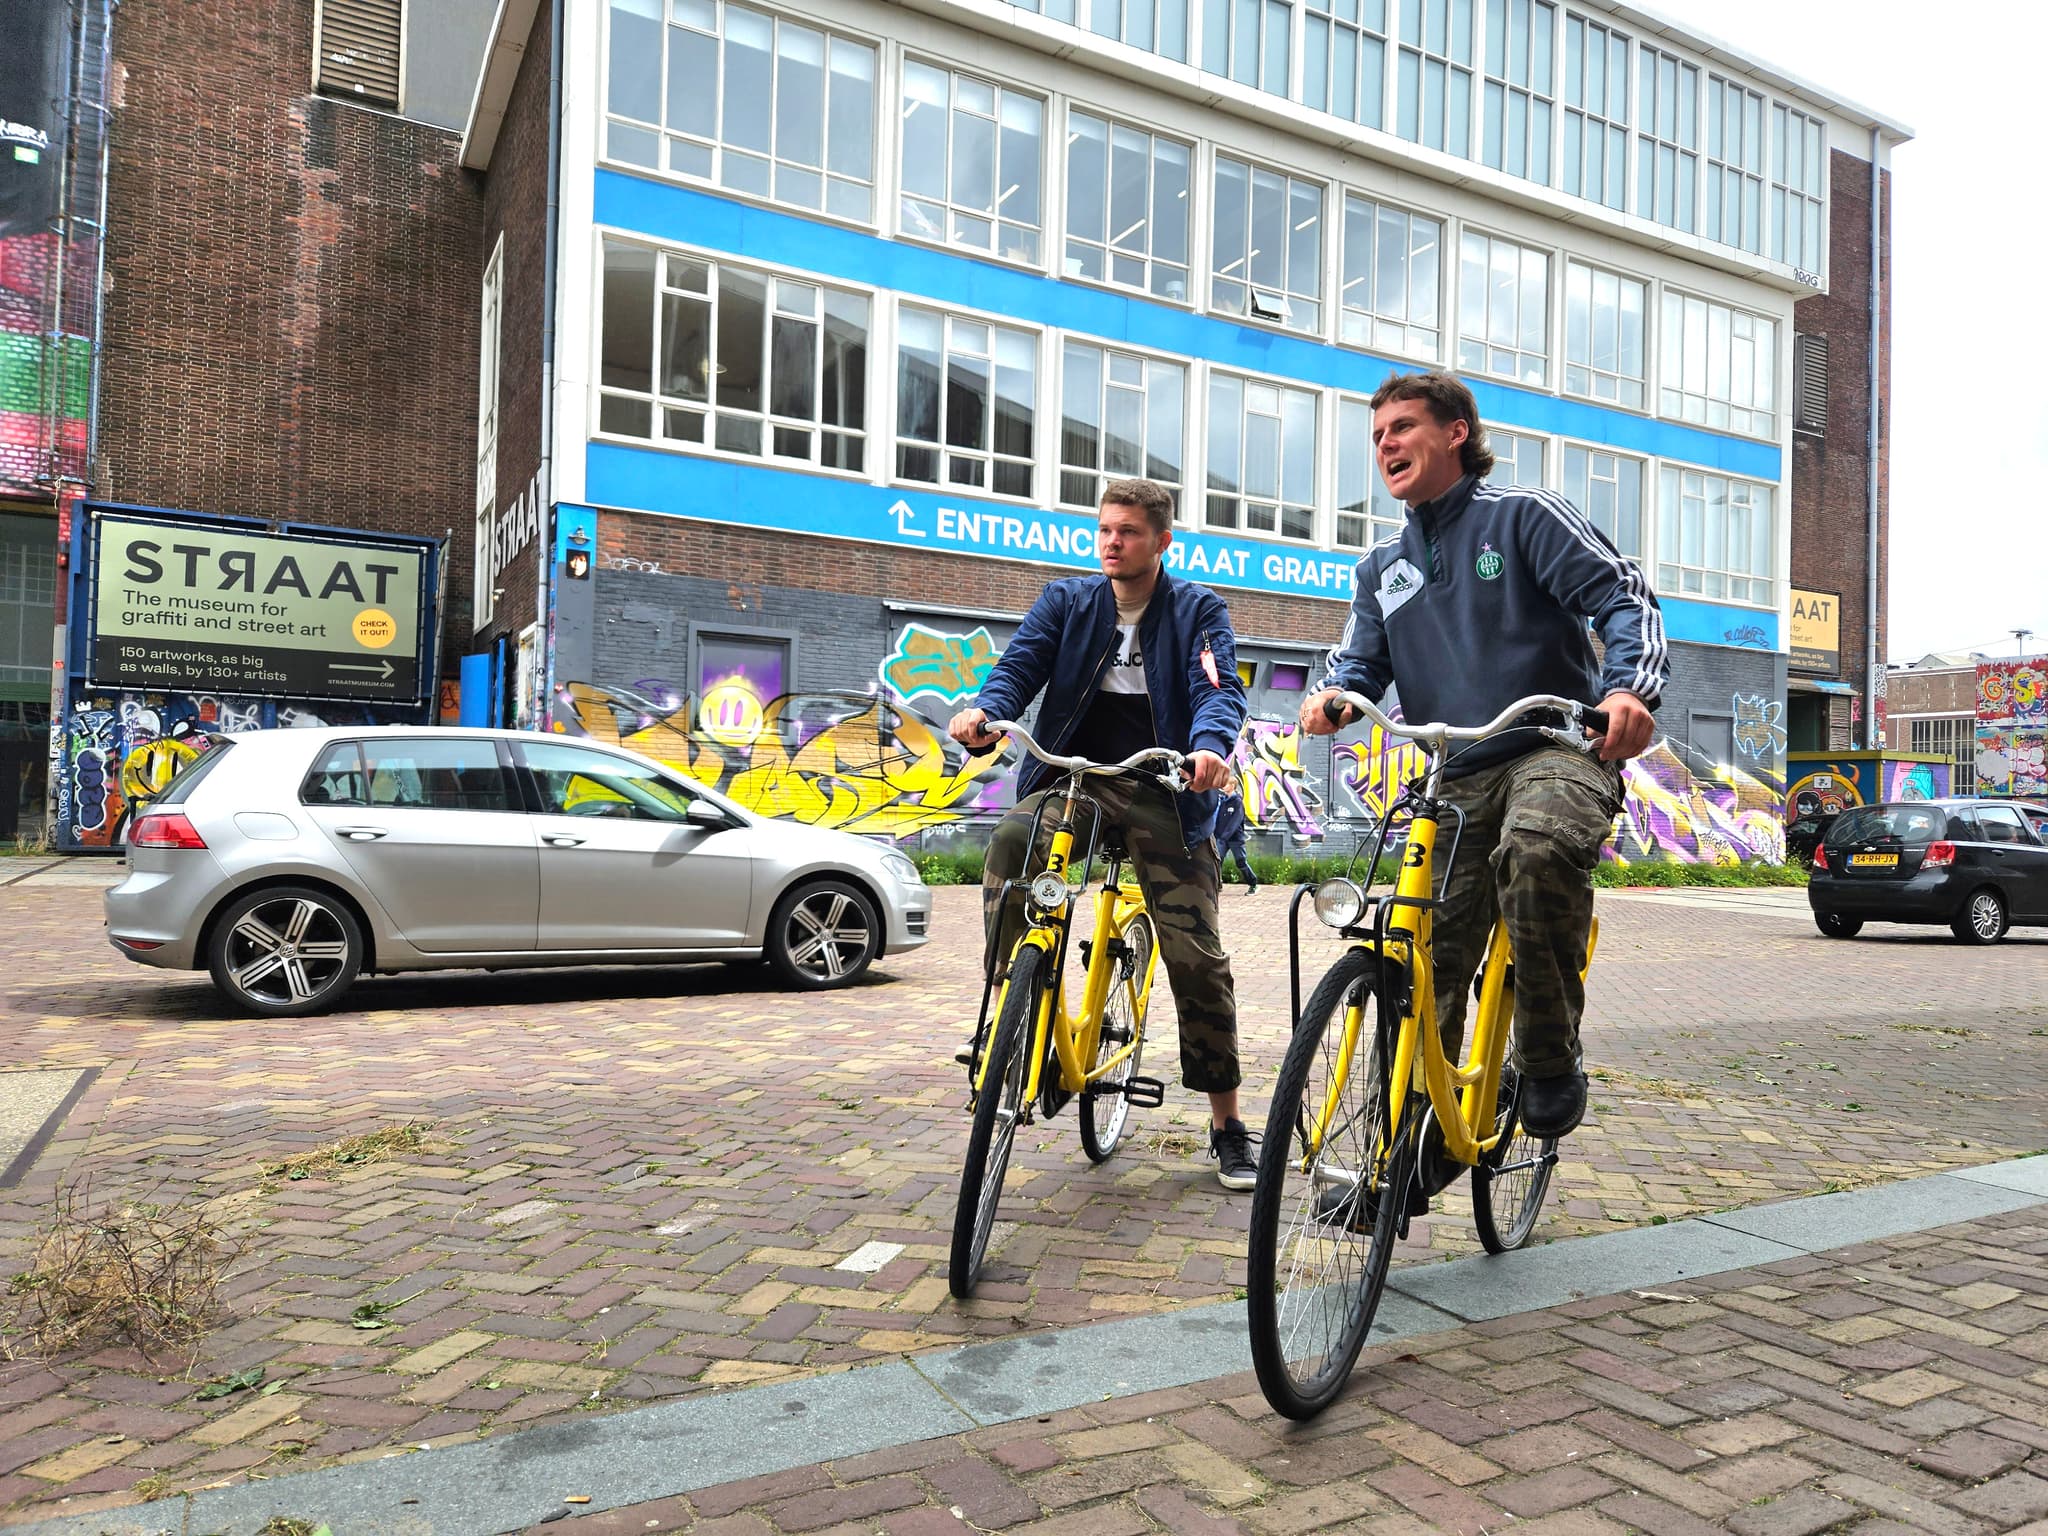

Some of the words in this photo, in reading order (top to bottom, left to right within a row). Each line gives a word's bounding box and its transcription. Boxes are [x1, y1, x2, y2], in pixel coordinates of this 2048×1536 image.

[494, 470, 541, 577] STRAA
[1167, 541, 1250, 578] RAAT
[1263, 554, 1357, 592] GRAFFI
[1387, 581, 1413, 595] adidas
[122, 589, 161, 606] The
[168, 597, 255, 614] museum
[260, 602, 288, 617] for
[1793, 598, 1831, 622] AAT
[122, 611, 187, 626] graffiti
[194, 616, 231, 630] and
[238, 618, 295, 635] street
[300, 624, 326, 637] art
[120, 646, 146, 658] 150
[150, 650, 217, 665] artworks,
[221, 655, 238, 664] as
[242, 655, 264, 668] big
[120, 663, 137, 672] as
[141, 663, 182, 676] walls,
[186, 665, 203, 678] by
[207, 666, 240, 678] 130+
[243, 670, 287, 681] artists
